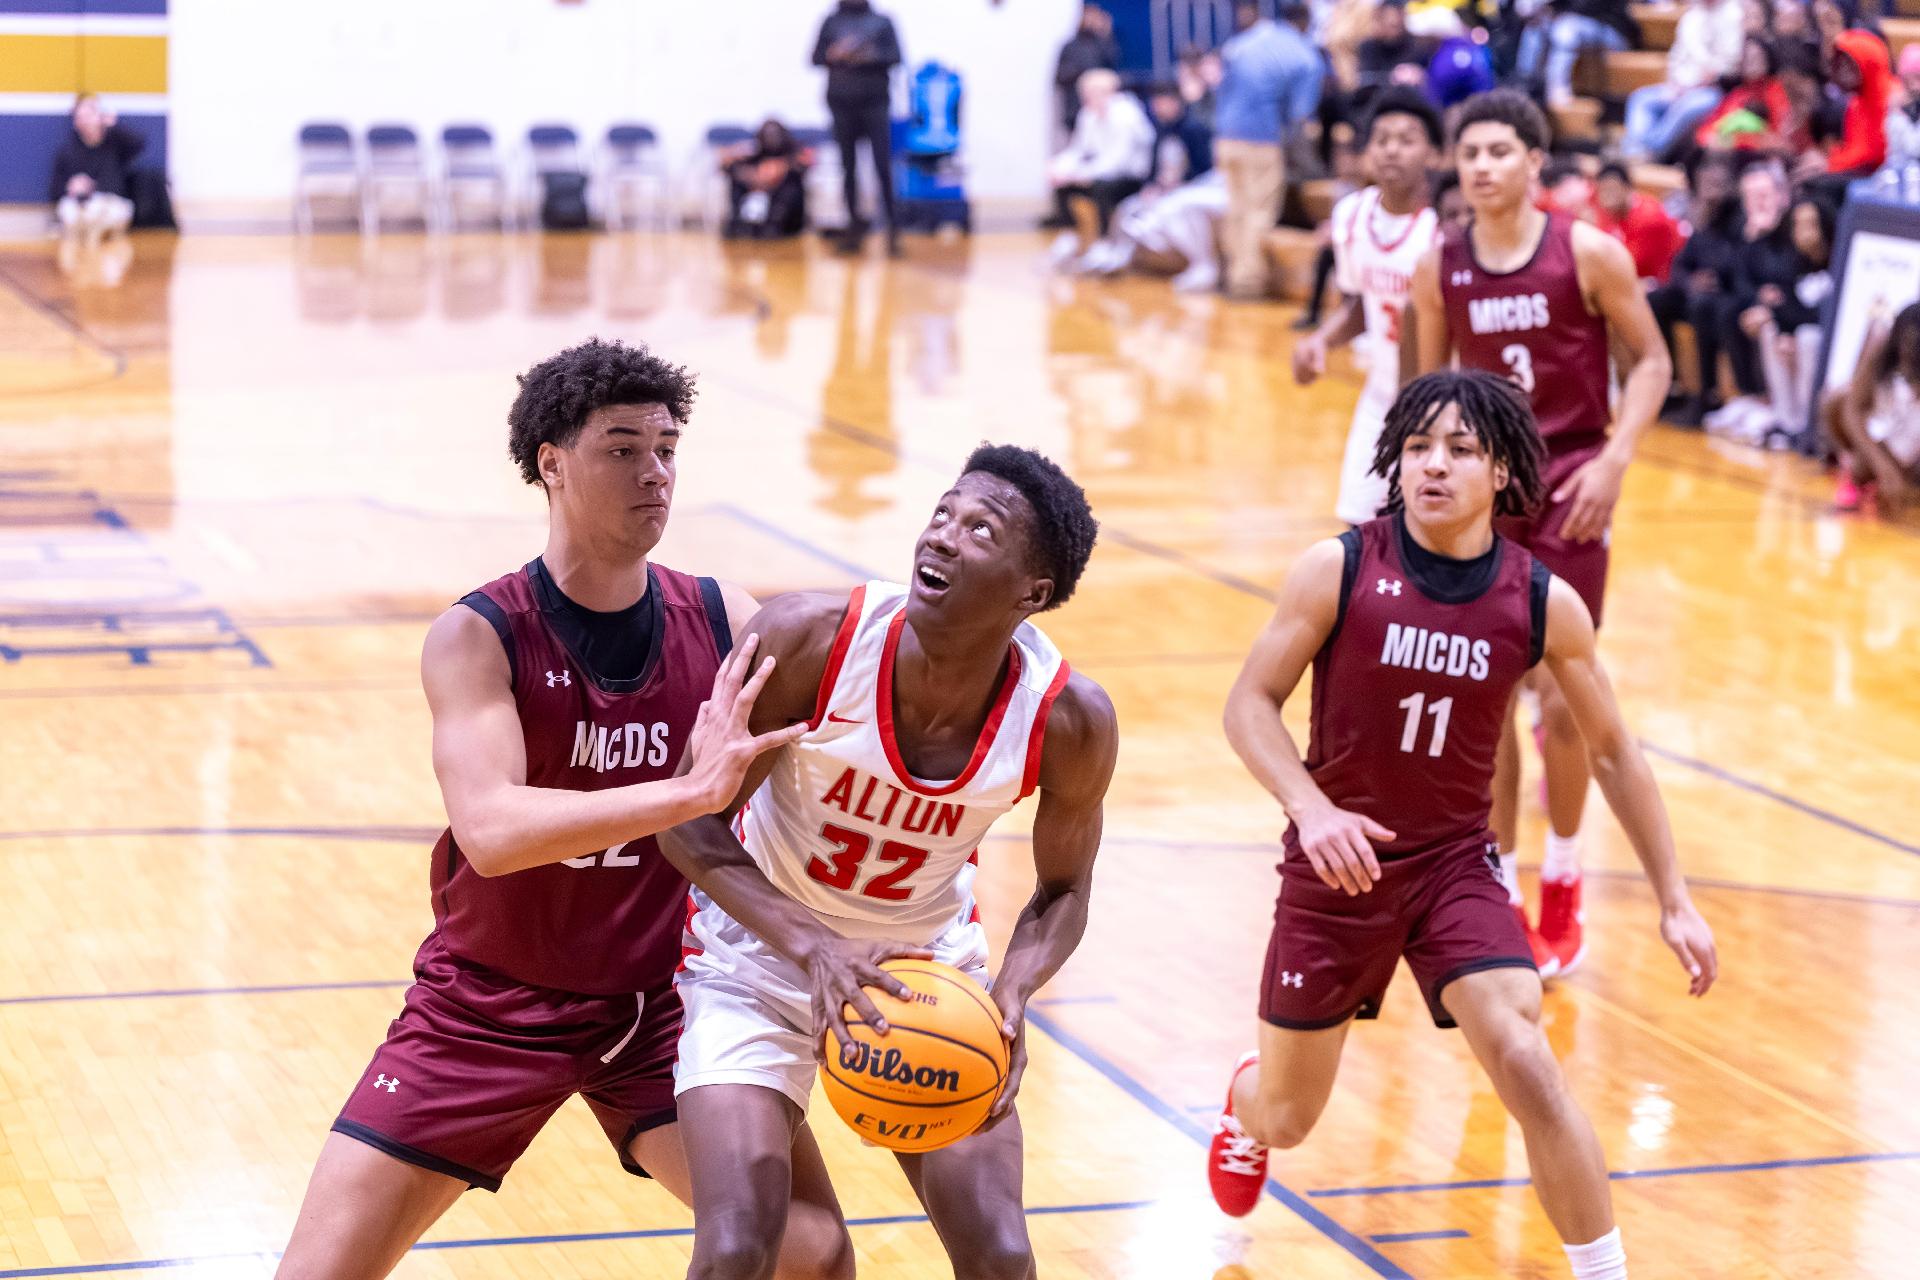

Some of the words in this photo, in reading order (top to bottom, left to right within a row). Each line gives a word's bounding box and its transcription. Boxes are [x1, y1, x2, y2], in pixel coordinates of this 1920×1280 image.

[1468, 293, 1550, 335] MICDS
[1501, 343, 1535, 393] 3
[1380, 622, 1491, 681] MICDS
[570, 720, 669, 773] MICDS
[1398, 691, 1453, 758] 11
[821, 766, 966, 837] ALTON
[804, 821, 932, 902] 32
[839, 1040, 960, 1092] Wilson
[854, 1112, 927, 1140] EVO
